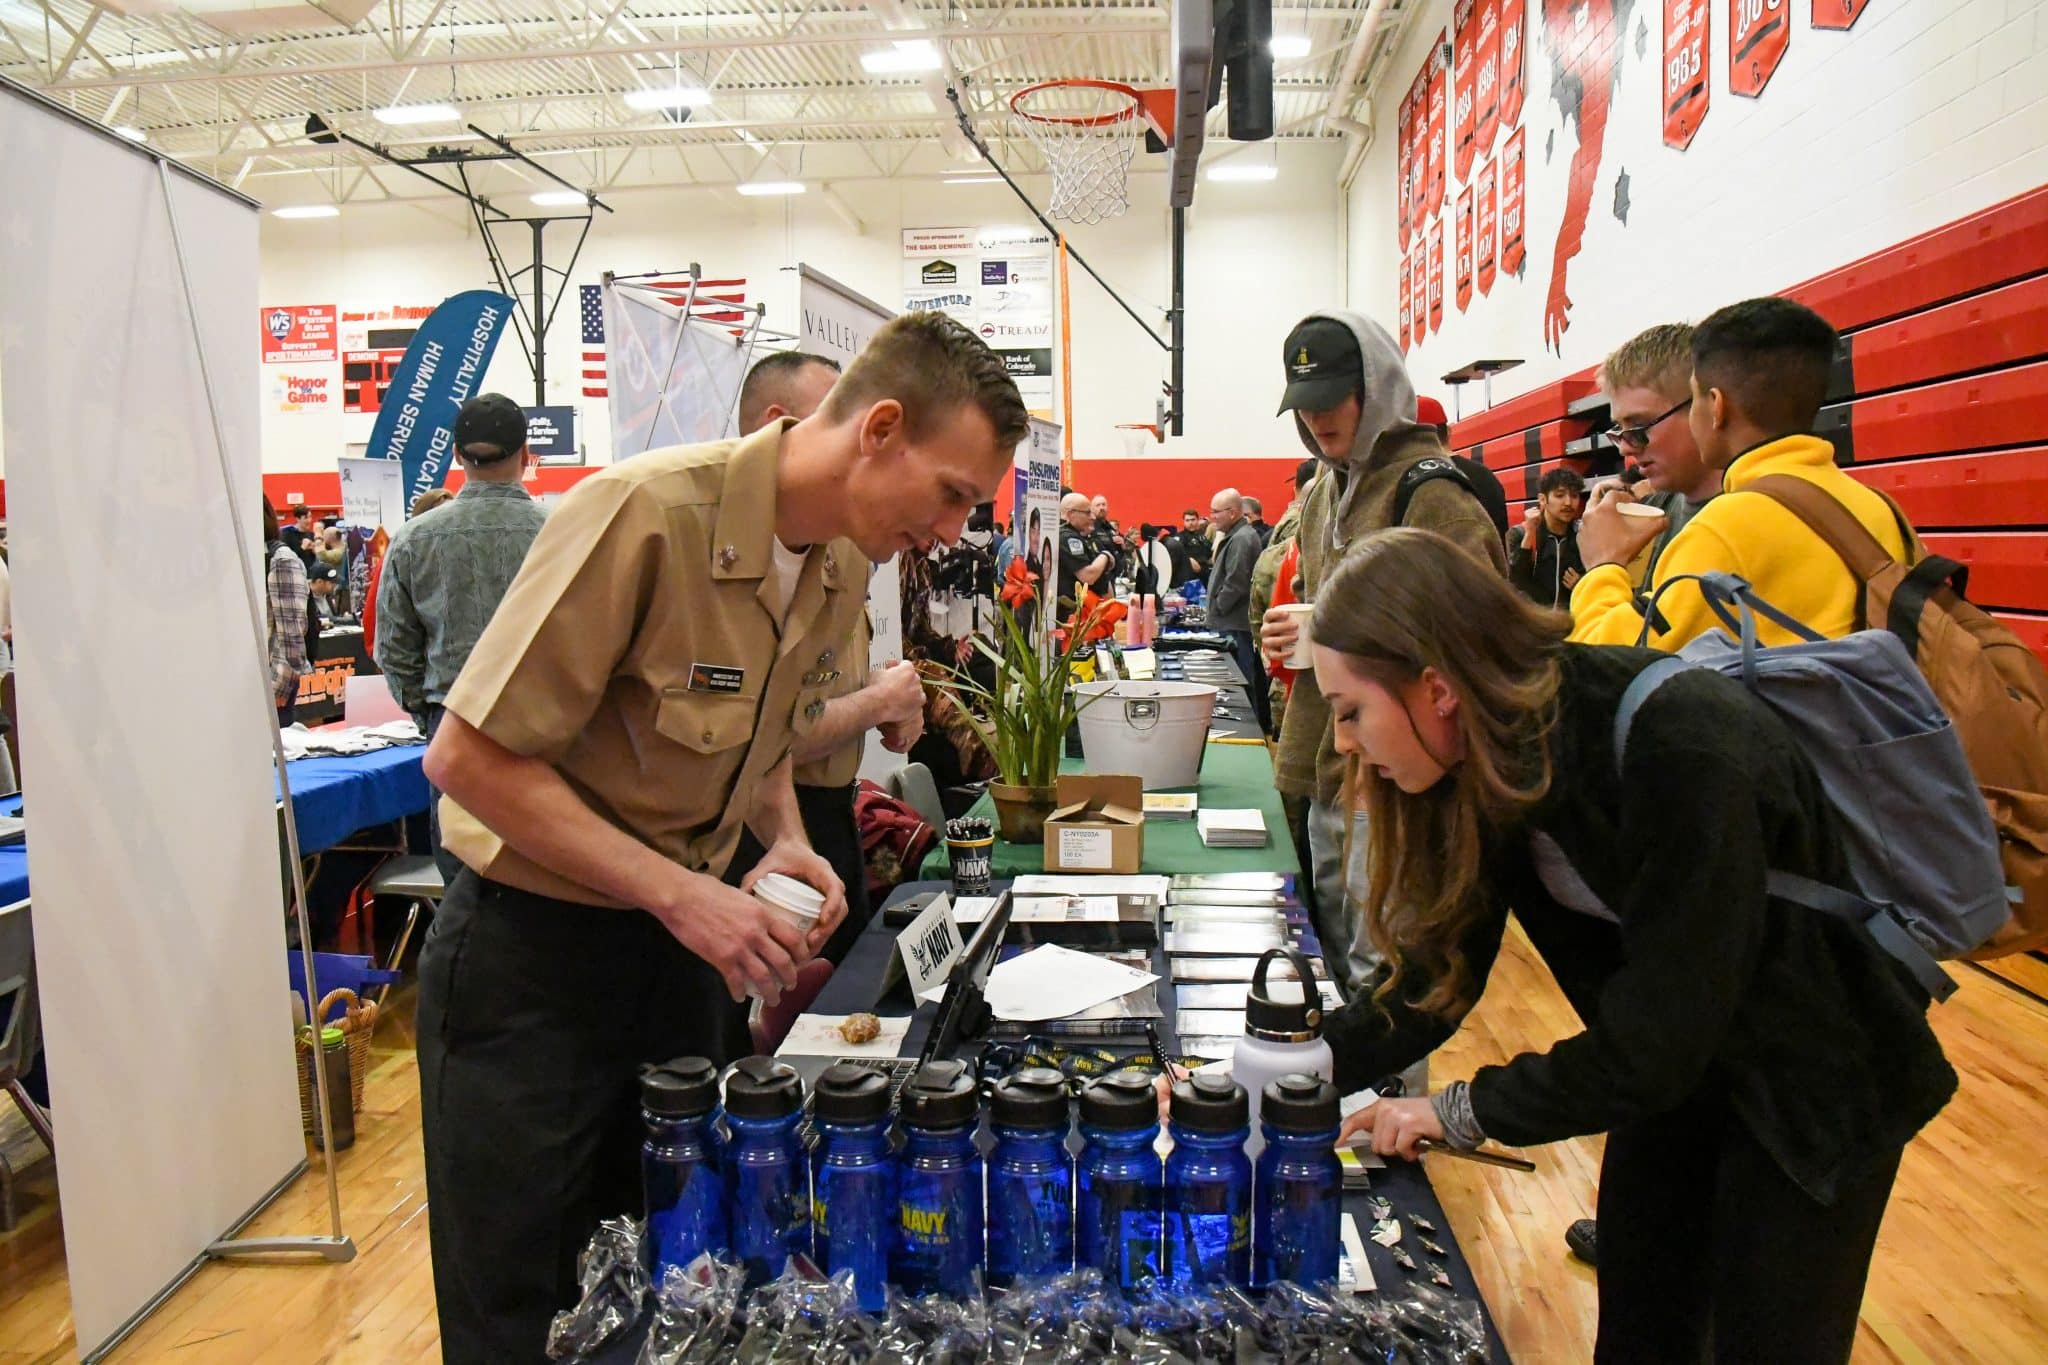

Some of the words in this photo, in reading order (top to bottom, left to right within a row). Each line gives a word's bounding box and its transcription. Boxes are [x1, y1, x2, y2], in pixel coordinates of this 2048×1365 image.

[269, 314, 290, 331] WS
[805, 309, 858, 355] VALLEY
[448, 305, 500, 409] HOSPITALITY
[288, 376, 328, 389] Honor
[408, 340, 444, 404] HUMAN
[288, 391, 328, 404] Game
[386, 403, 420, 461] SERVIC
[1029, 461, 1060, 480] ENSURING
[957, 860, 988, 877] NAVY
[925, 917, 954, 969] NAVY
[902, 1205, 946, 1234] NAVY
